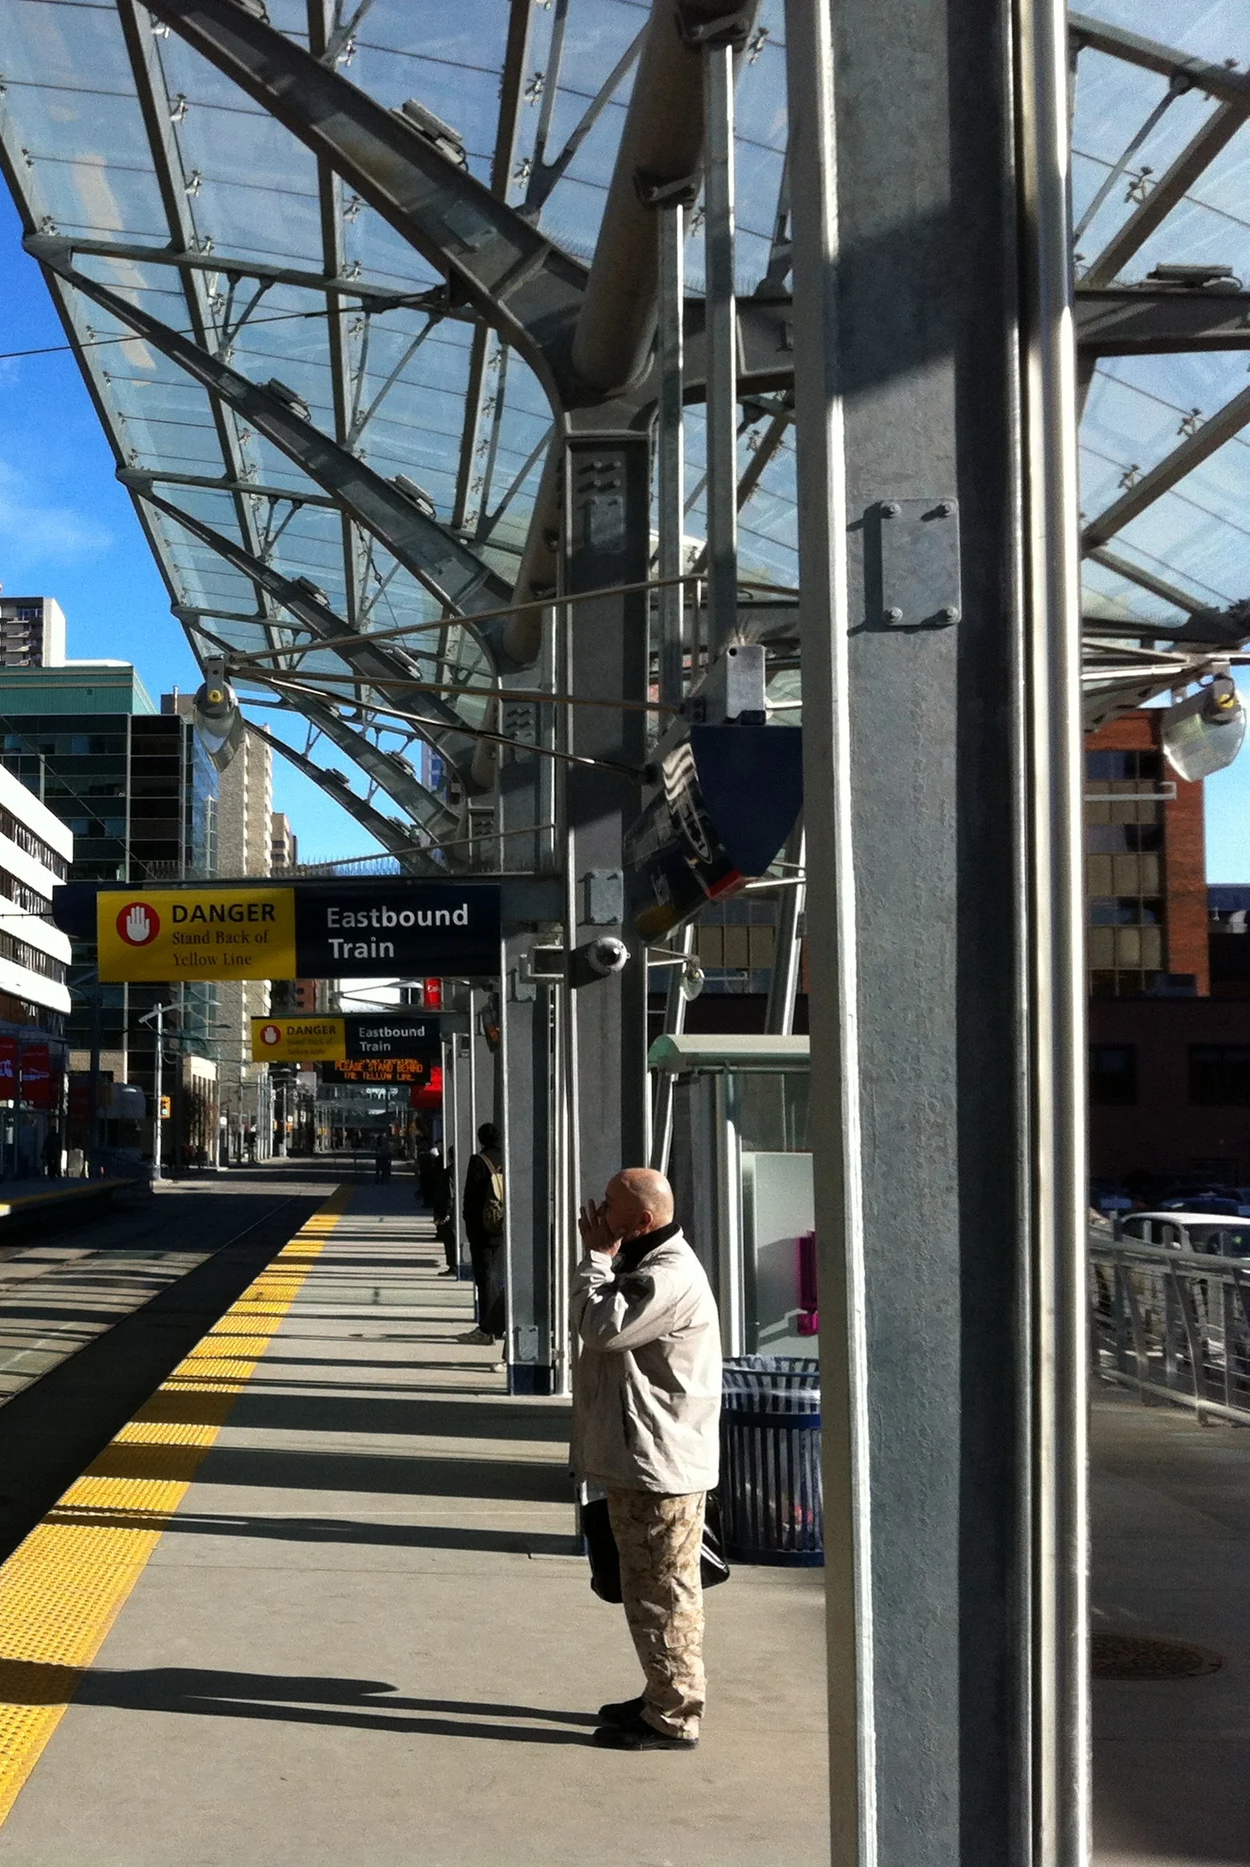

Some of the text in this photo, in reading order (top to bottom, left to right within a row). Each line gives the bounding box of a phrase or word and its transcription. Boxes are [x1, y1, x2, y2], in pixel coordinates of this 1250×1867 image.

[172, 904, 276, 923] DANGER
[327, 903, 469, 928] Eastbound
[172, 929, 269, 945] Stand Back of
[328, 936, 395, 959] Train
[173, 952, 253, 966] Yellow Line
[286, 1026, 336, 1036] DANGER
[359, 1025, 426, 1038] Eastbound
[360, 1041, 391, 1052] Train
